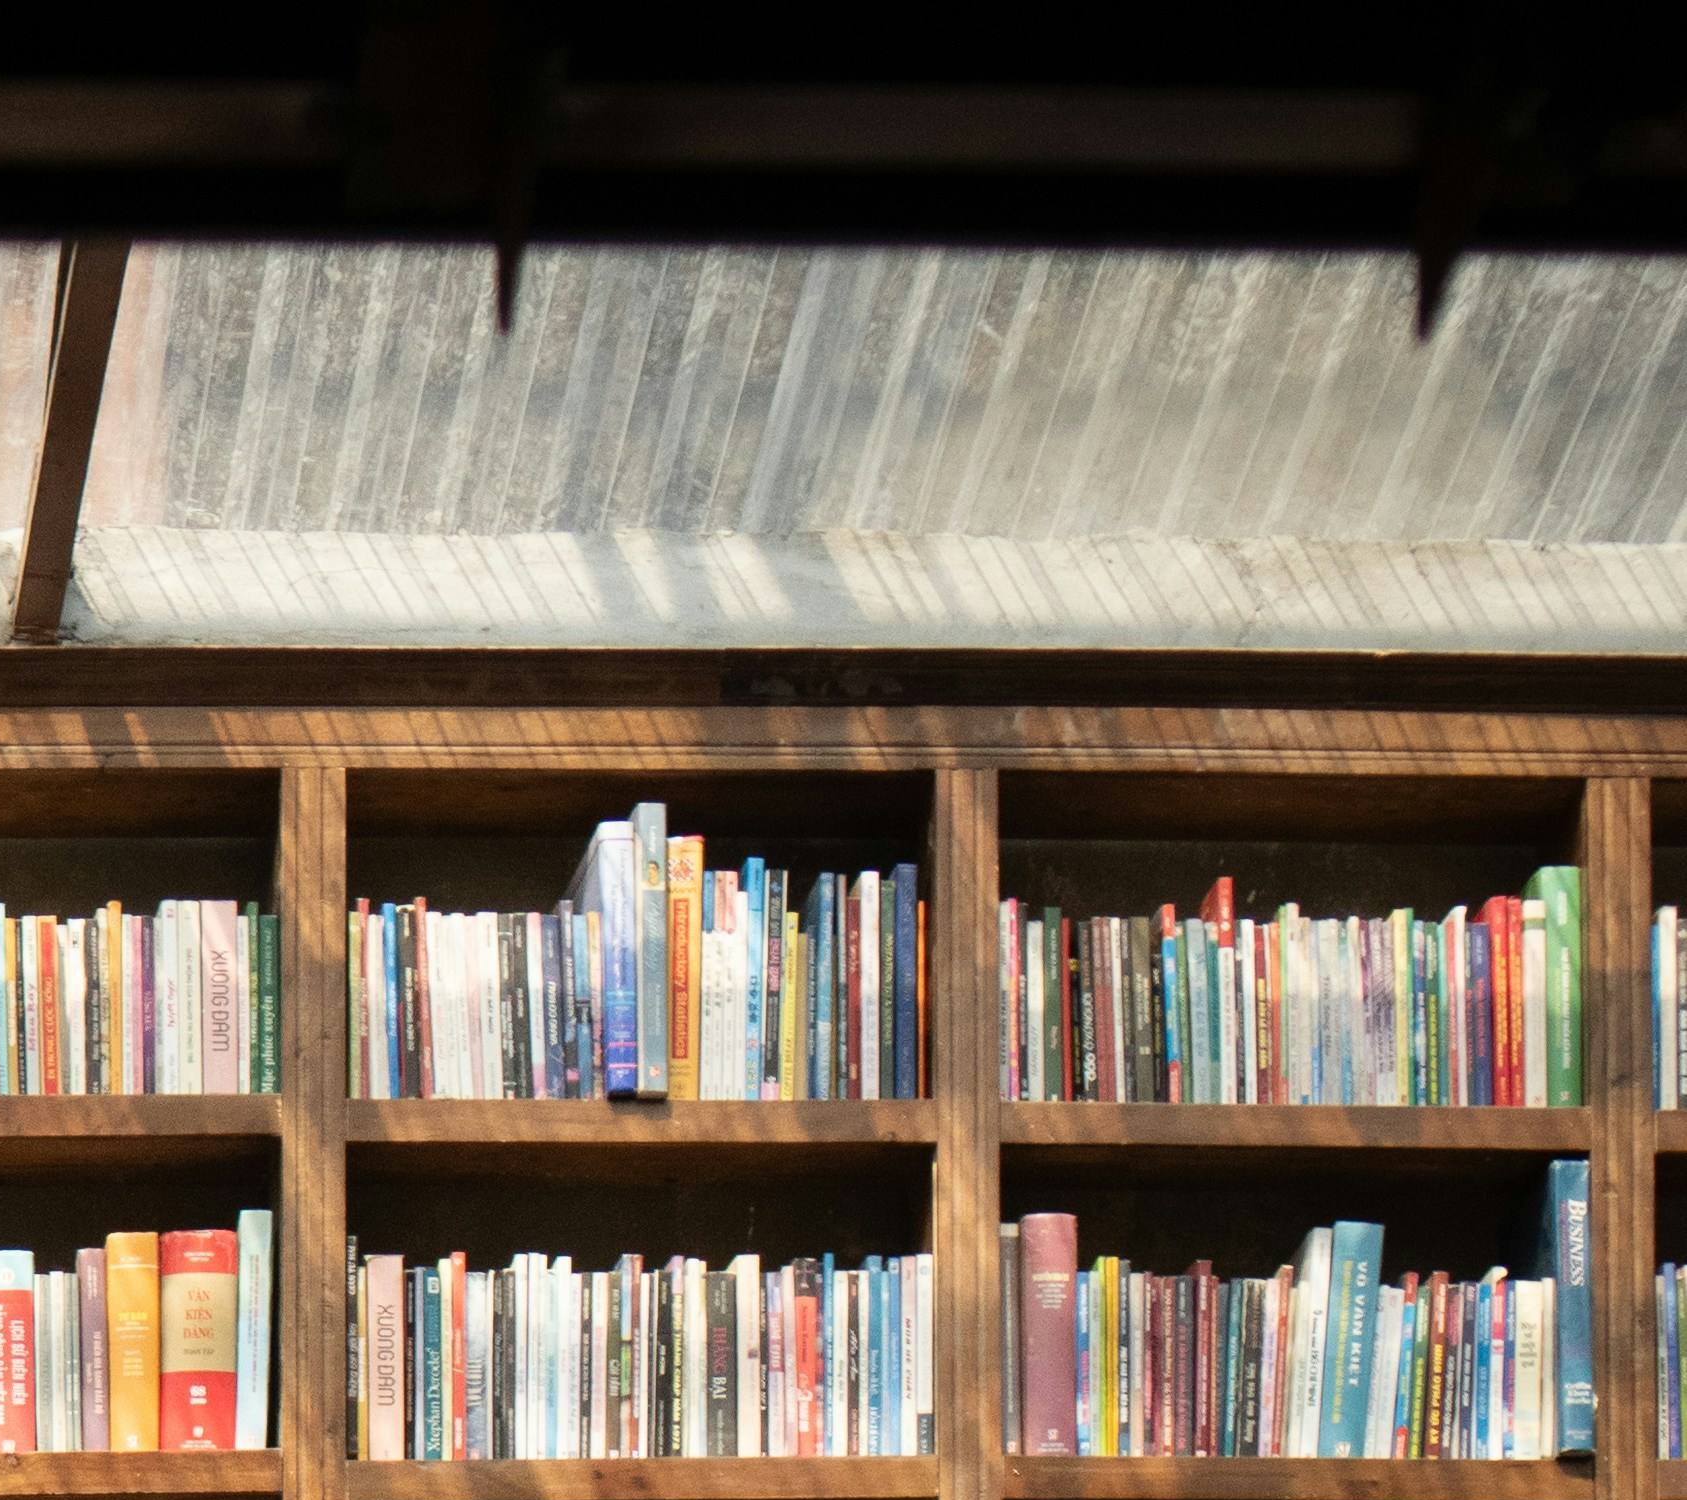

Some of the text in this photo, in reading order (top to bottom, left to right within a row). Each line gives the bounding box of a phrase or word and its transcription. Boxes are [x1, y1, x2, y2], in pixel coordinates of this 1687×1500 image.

[673, 901, 688, 1057] Introductory Statistics
[1356, 1261, 1369, 1282] VÕ
[1568, 1199, 1587, 1287] BUSINESS
[1352, 1294, 1369, 1336] VĂN
